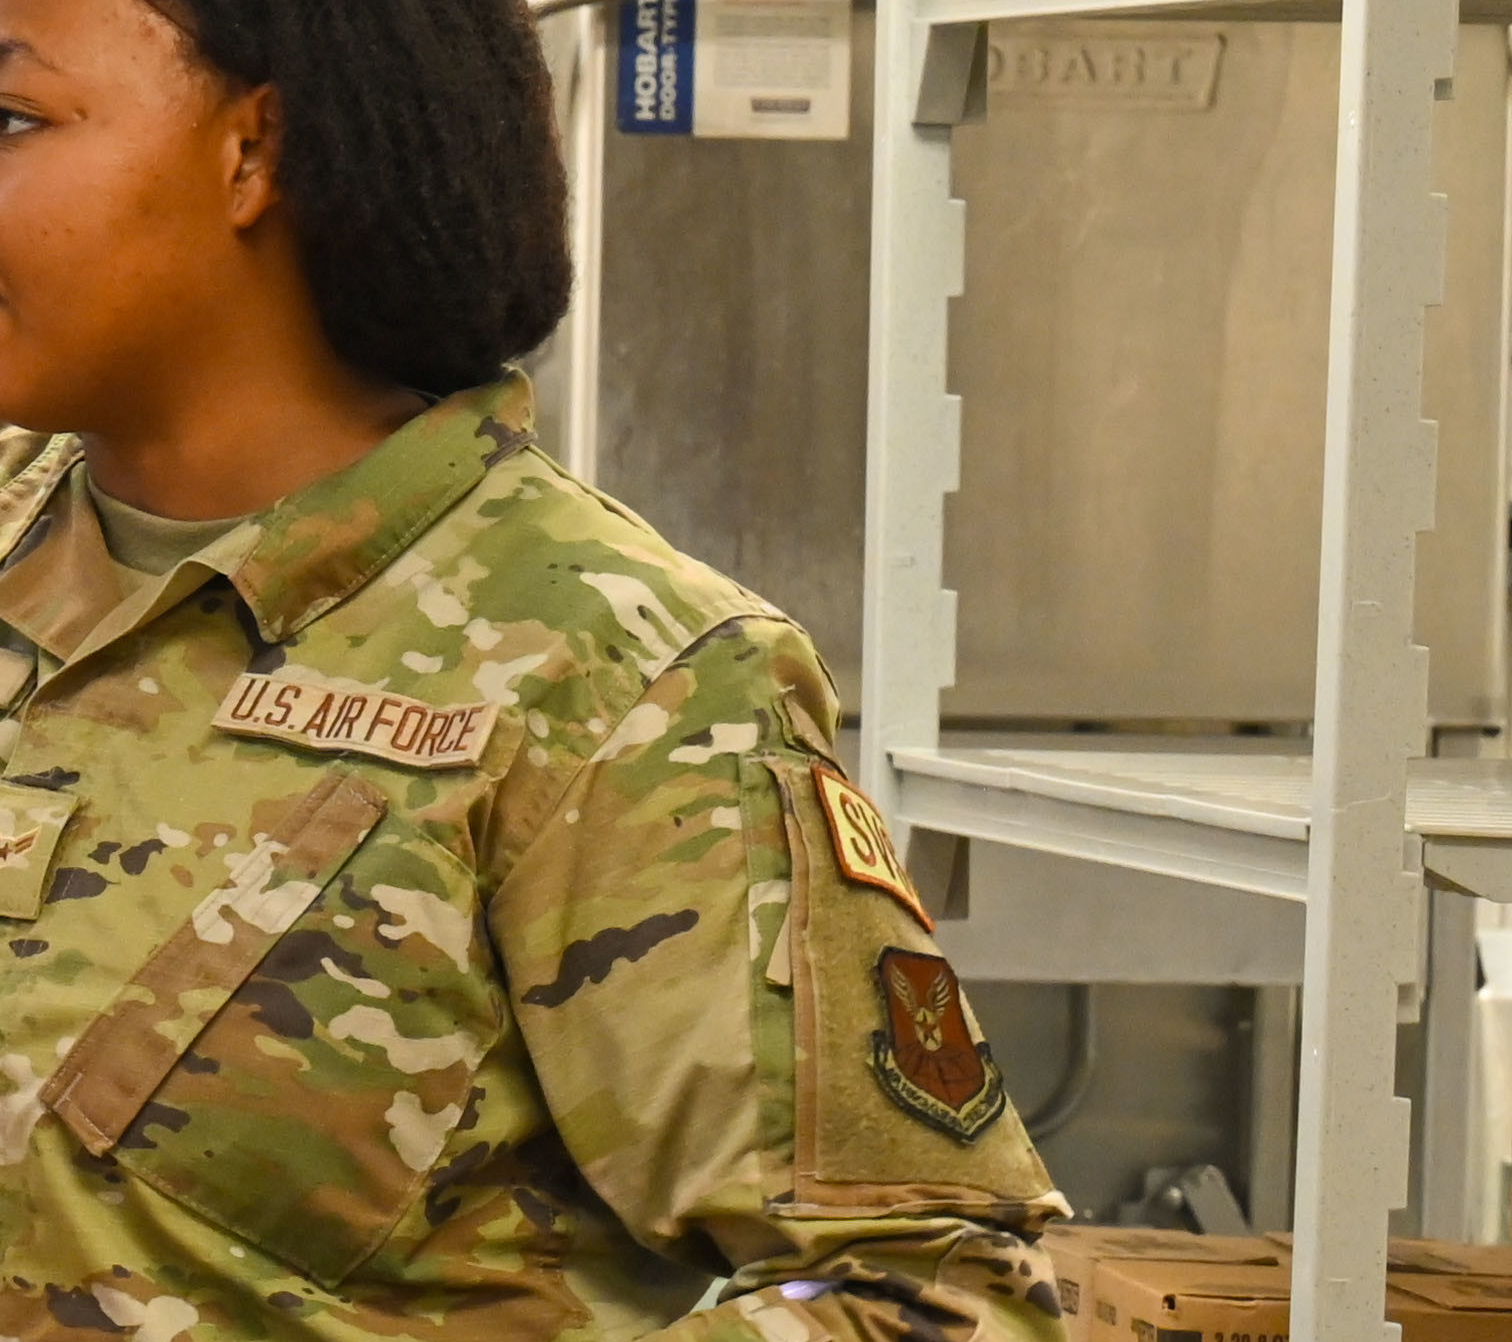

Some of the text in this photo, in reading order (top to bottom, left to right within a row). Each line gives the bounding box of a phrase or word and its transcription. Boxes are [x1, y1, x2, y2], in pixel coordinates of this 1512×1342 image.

[230, 678, 486, 756] U.S. AIR FORCE
